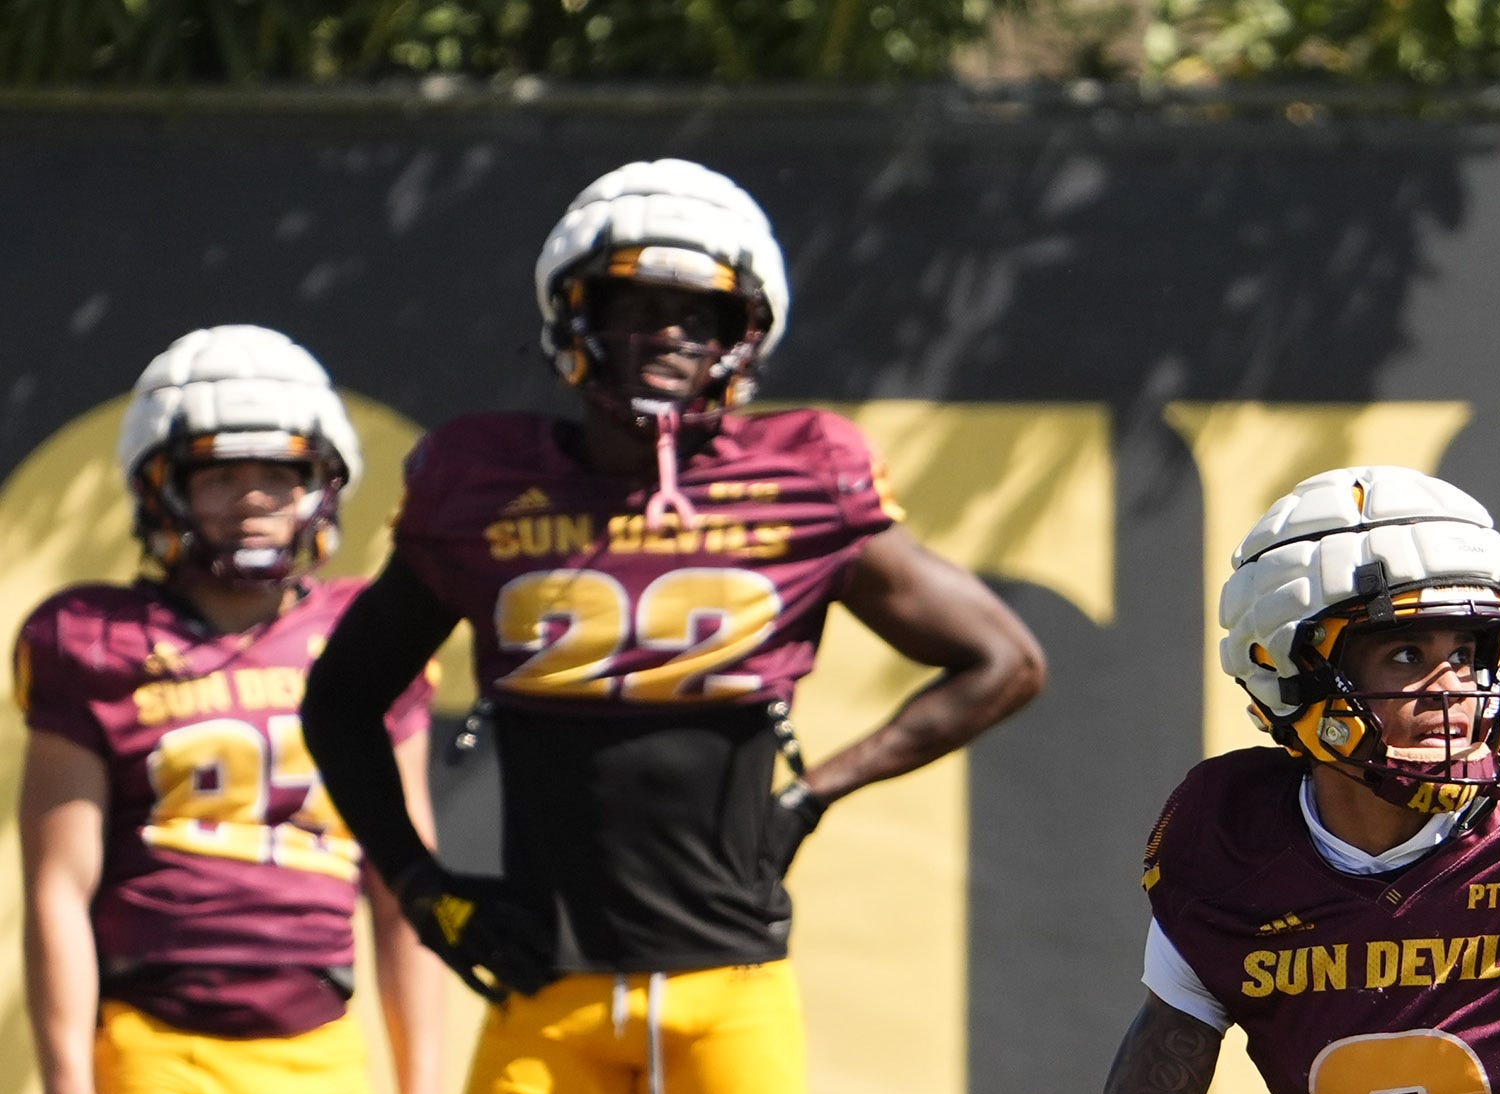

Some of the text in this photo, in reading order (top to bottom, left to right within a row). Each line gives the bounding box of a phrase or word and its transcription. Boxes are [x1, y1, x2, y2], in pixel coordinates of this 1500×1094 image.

[484, 514, 592, 561] SUN
[494, 567, 782, 701] 22
[1241, 943, 1349, 998] SUN
